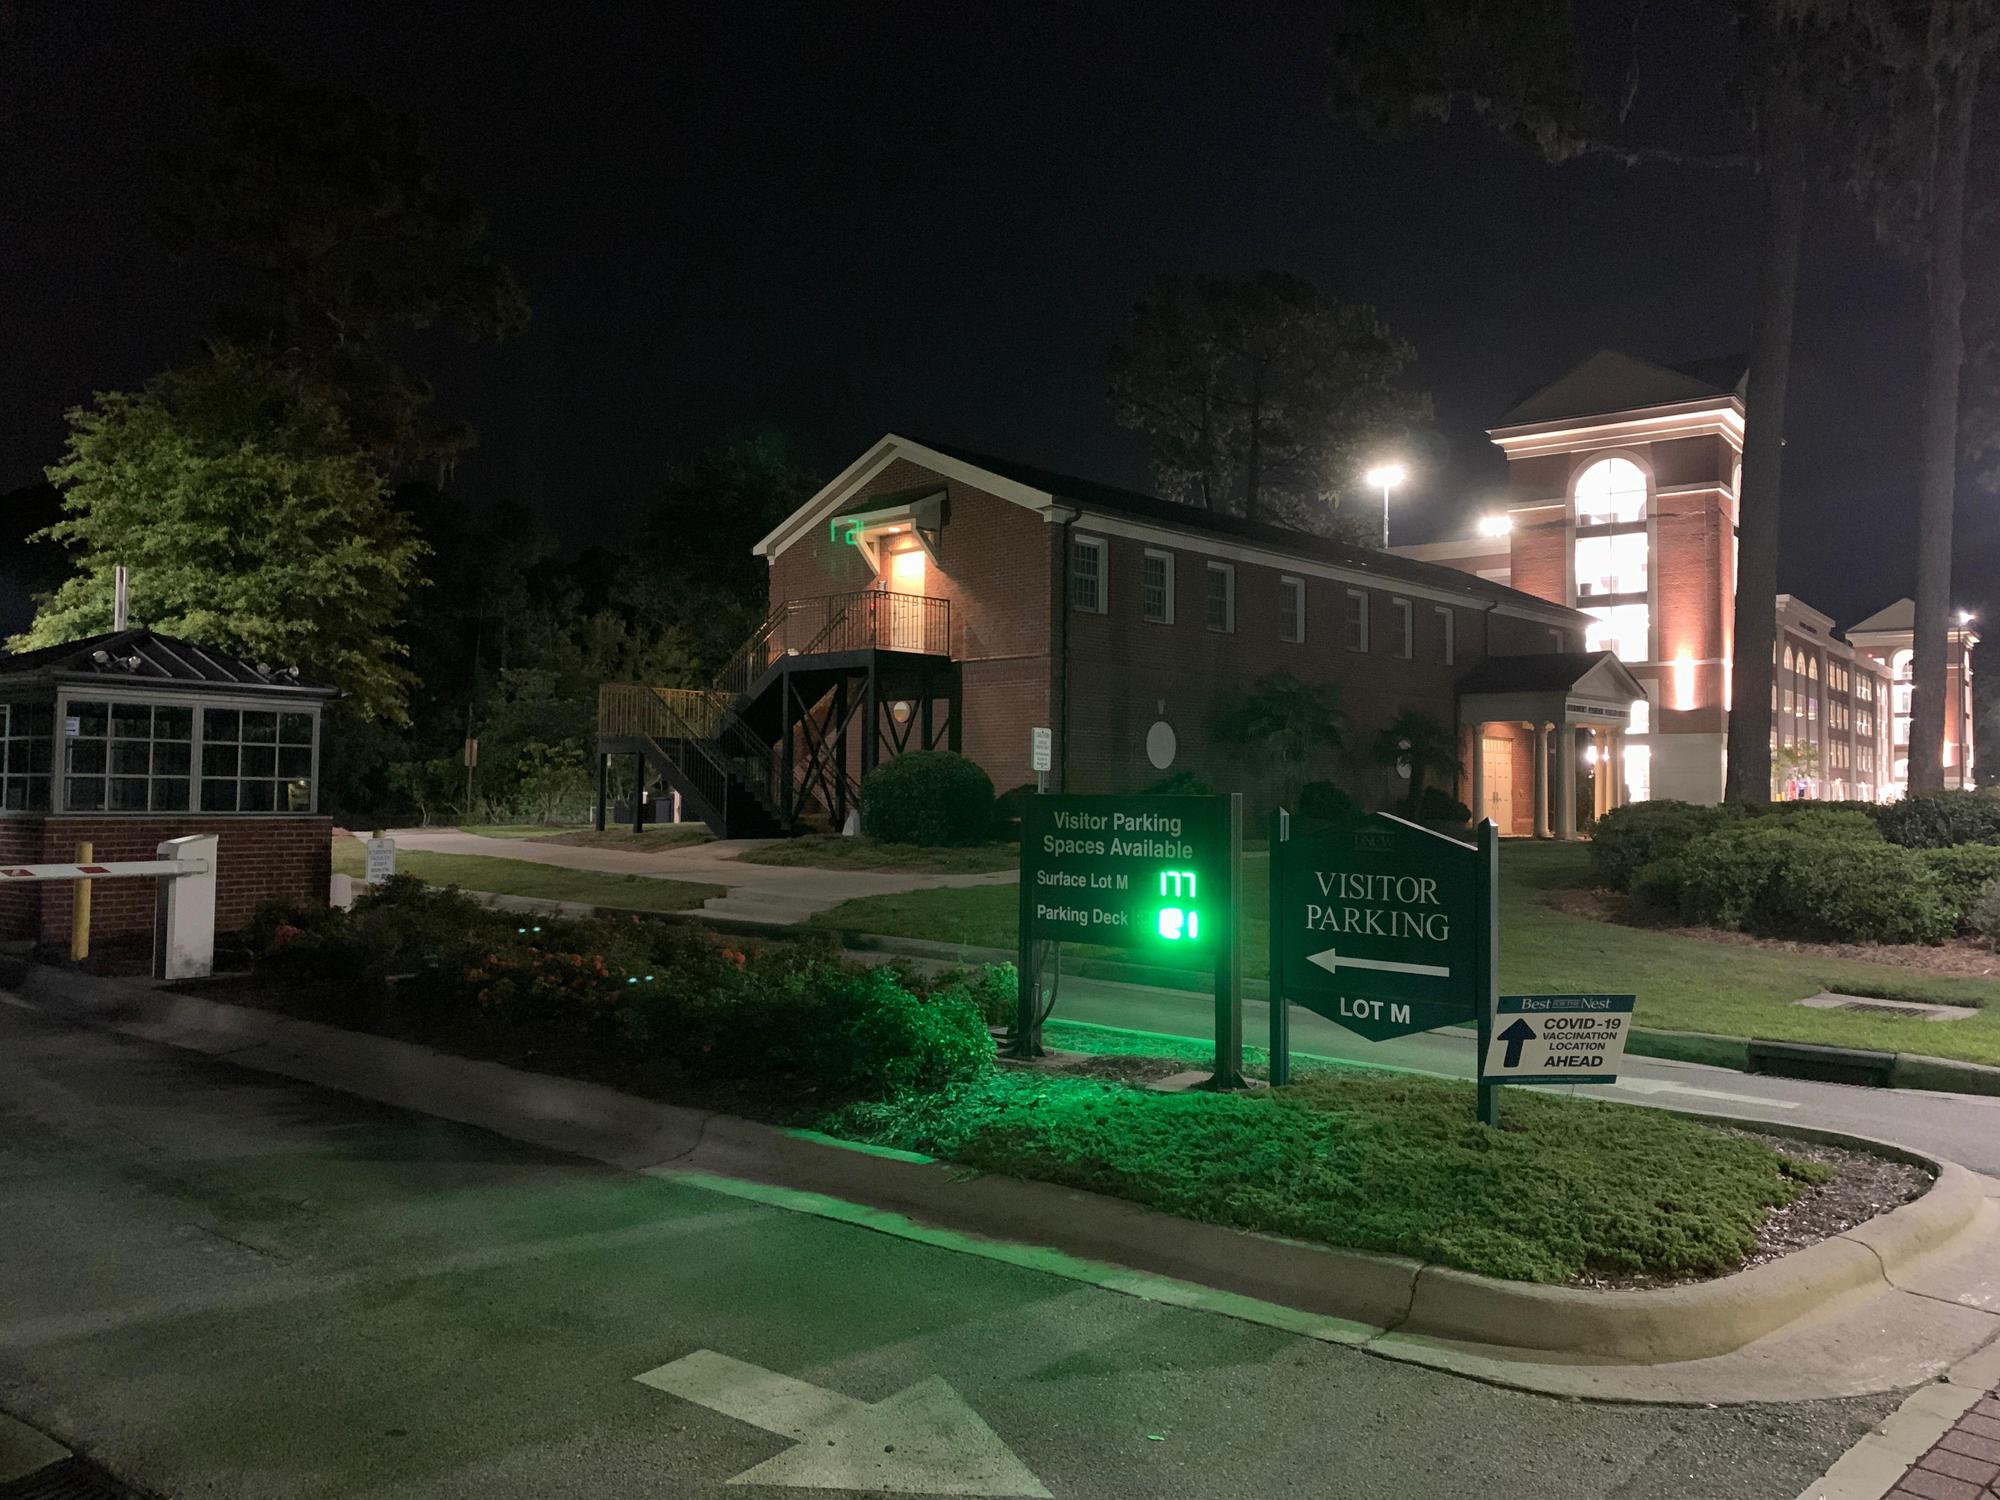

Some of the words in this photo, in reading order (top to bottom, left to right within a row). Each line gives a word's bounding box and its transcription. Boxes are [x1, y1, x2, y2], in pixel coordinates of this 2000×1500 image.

[1054, 811, 1108, 830] Visitor
[1113, 813, 1182, 837] Parking
[1043, 835, 1104, 856] Spaces
[1110, 838, 1193, 859] Available
[1037, 870, 1087, 887] Surface
[1091, 873, 1112, 889] Lot
[1116, 874, 1128, 889] M
[1315, 871, 1440, 905] VISITOR
[1037, 904, 1088, 926] Parking
[1093, 908, 1129, 926] Deck
[1305, 904, 1450, 941] PARKING
[1340, 997, 1384, 1020] LOT
[1390, 1003, 1411, 1024] M
[1521, 998, 1551, 1010] Best
[1580, 997, 1612, 1009] Nest
[1542, 1031, 1618, 1041] VACCINATION
[1549, 1042, 1606, 1051] LOCATION
[1543, 1055, 1604, 1068] AHEAD
